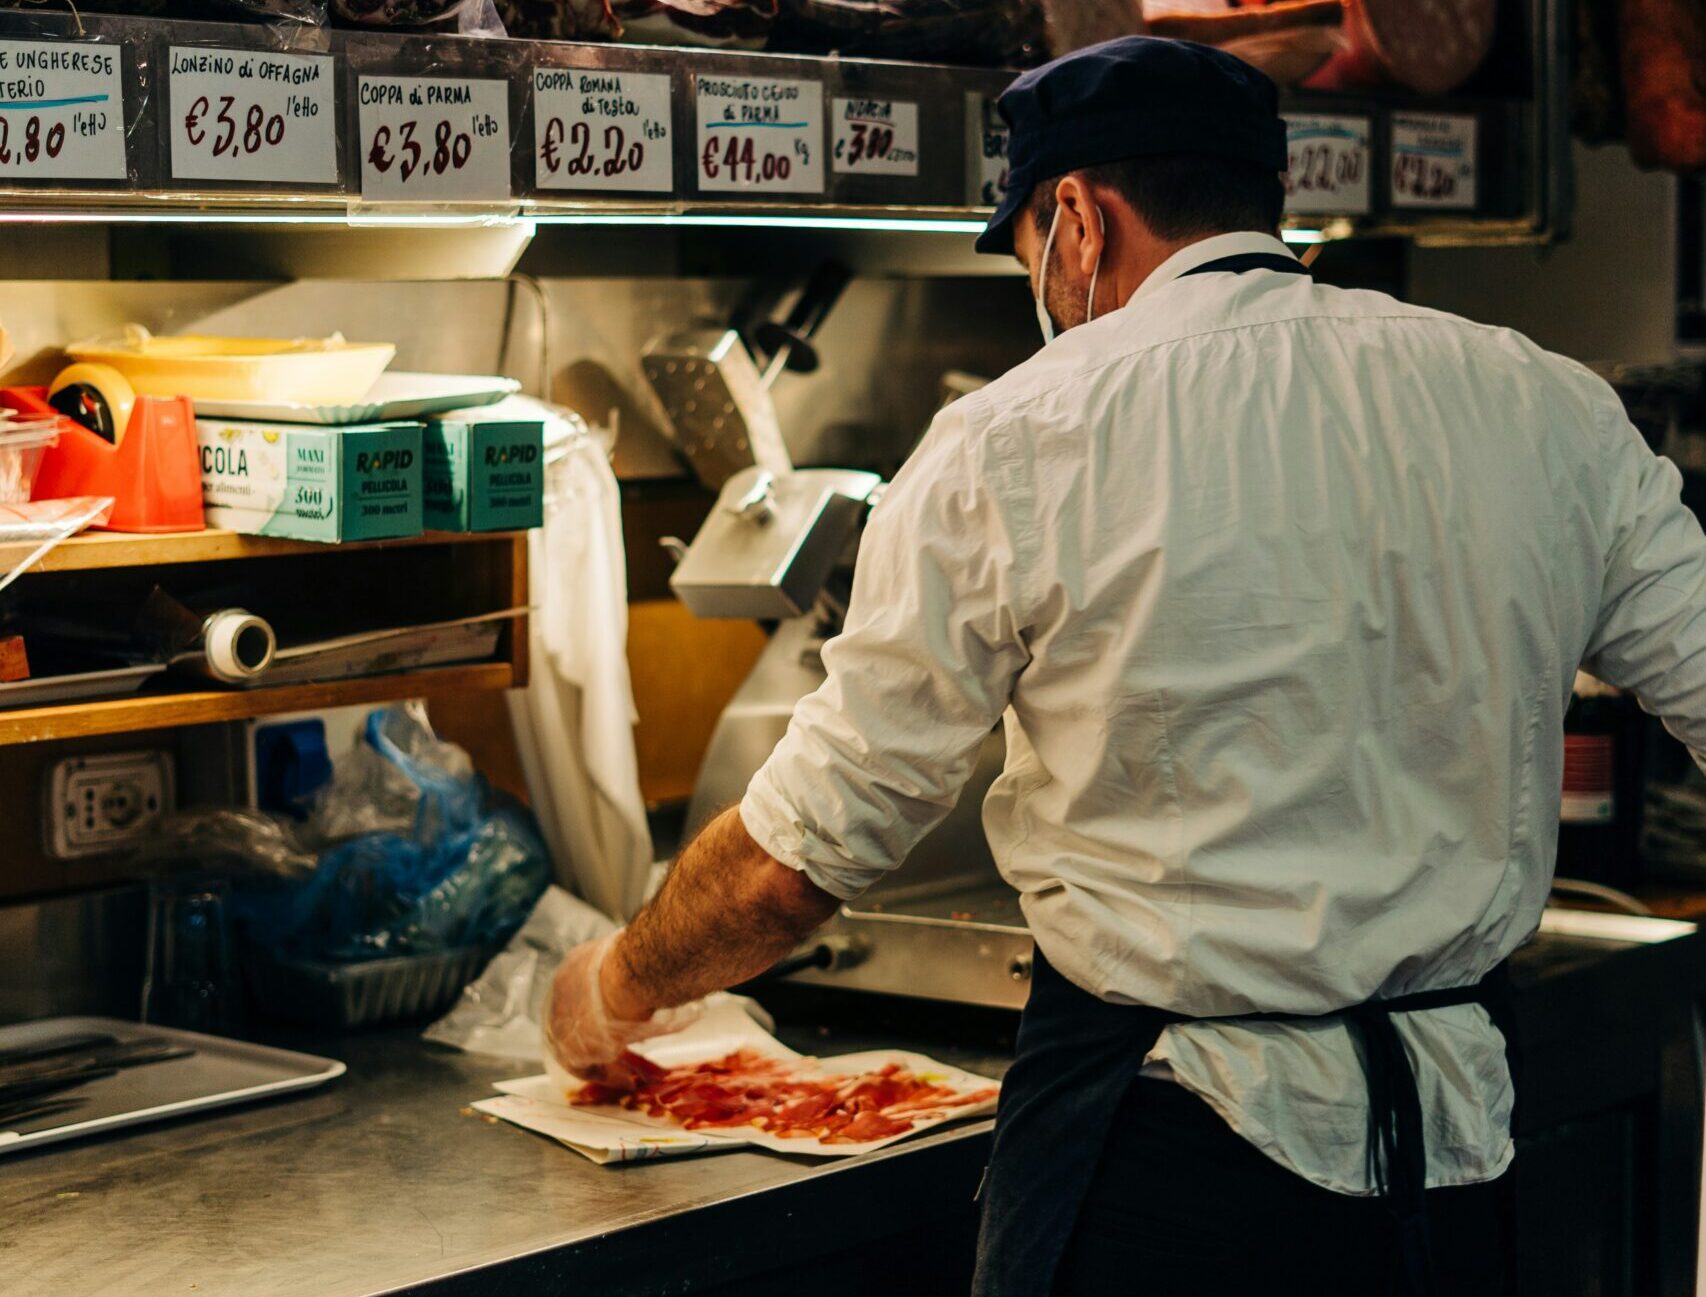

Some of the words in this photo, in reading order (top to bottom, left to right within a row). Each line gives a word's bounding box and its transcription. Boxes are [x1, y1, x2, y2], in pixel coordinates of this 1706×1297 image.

[16, 50, 113, 76] UNGHERESE
[238, 58, 254, 78] di
[258, 61, 320, 85] OFFAGNA
[360, 82, 403, 105] COPPA
[409, 84, 423, 106] di
[427, 85, 472, 105] PARMA
[536, 71, 574, 92] COPPA
[580, 75, 622, 94] ROMANA
[286, 94, 320, 118] l'etto
[581, 96, 596, 115] di
[597, 95, 640, 117] Testa
[356, 448, 413, 474] RAPID
[484, 443, 538, 467] RAPID
